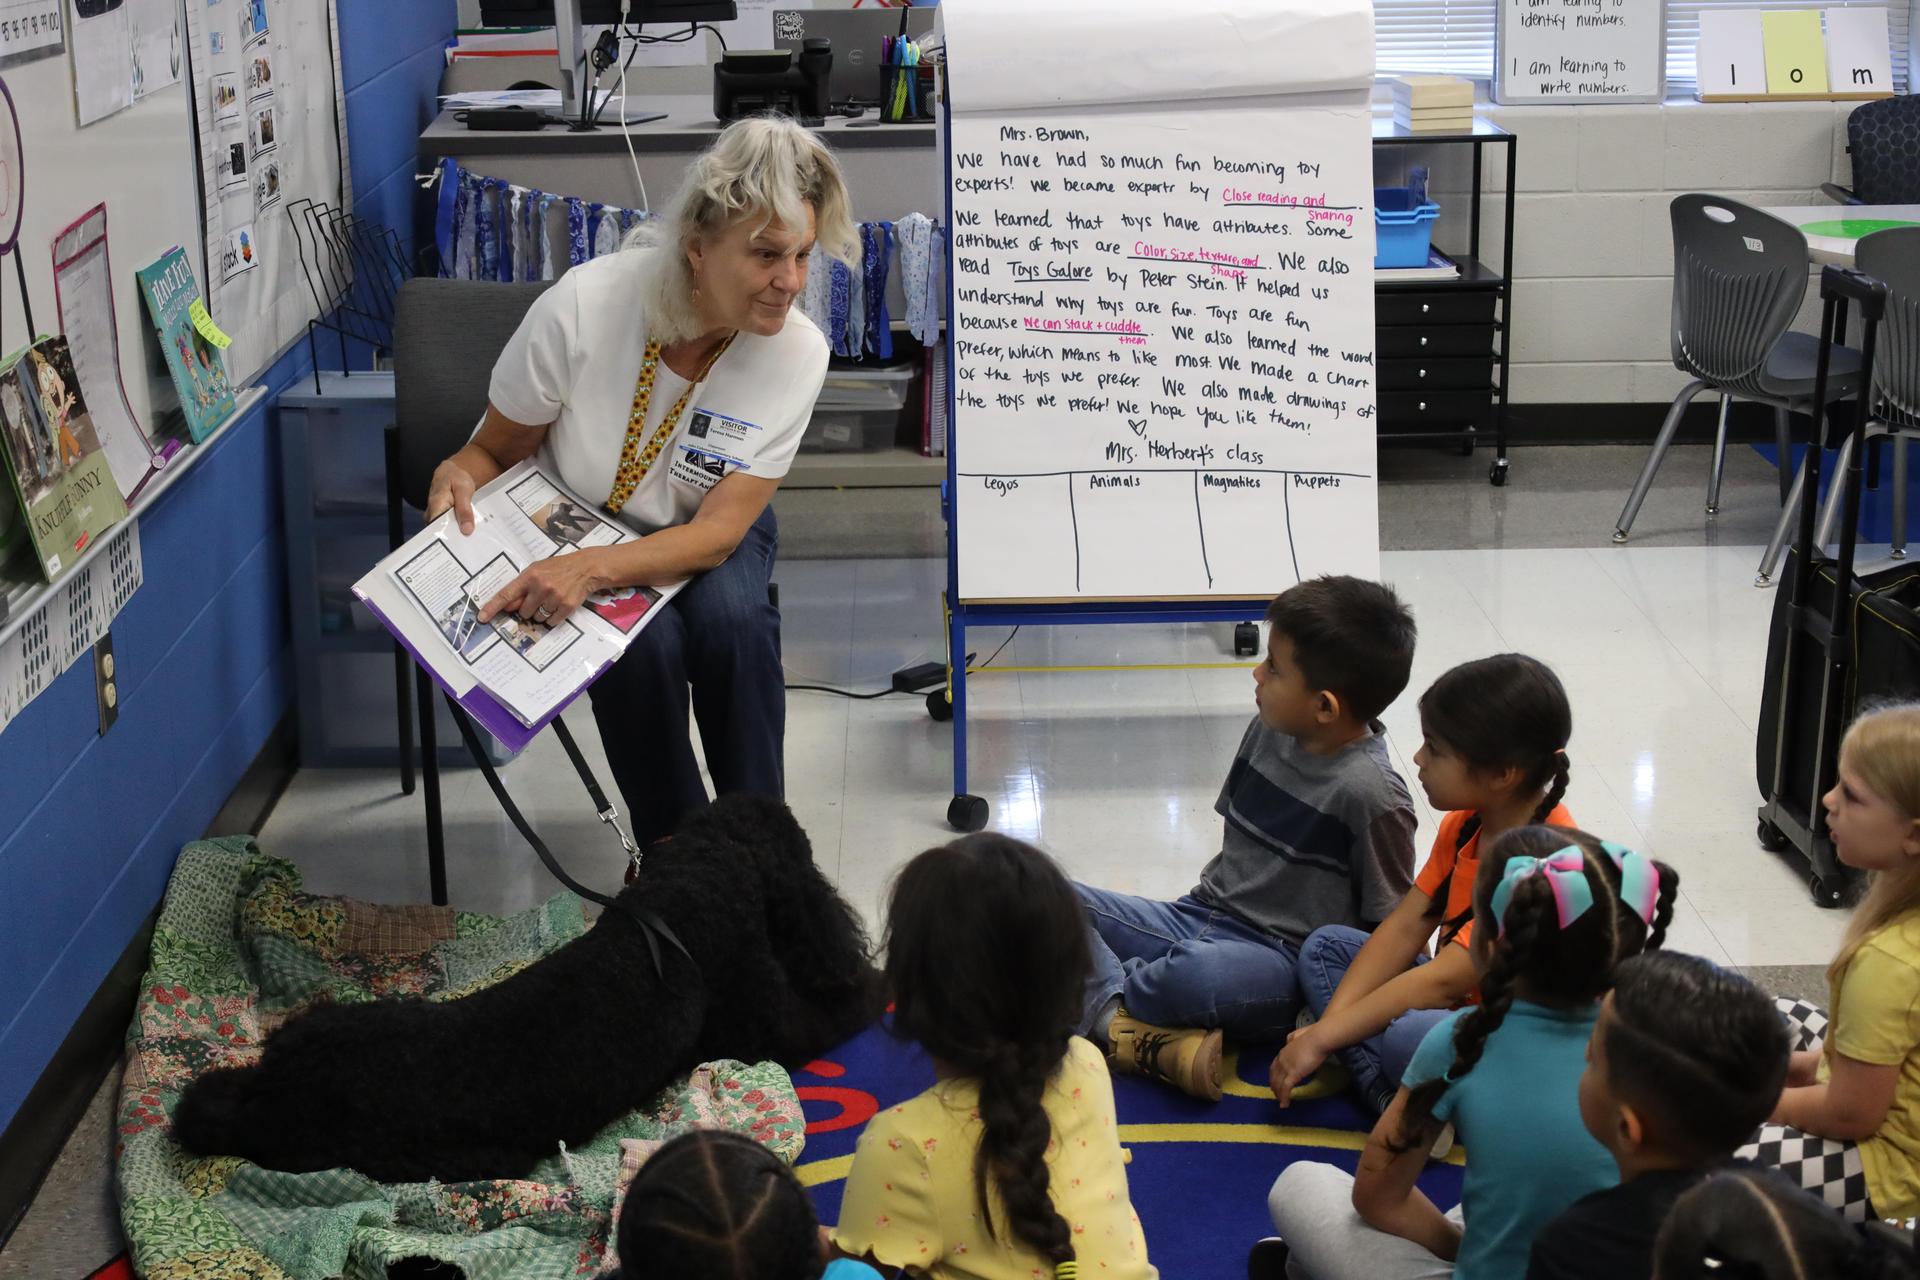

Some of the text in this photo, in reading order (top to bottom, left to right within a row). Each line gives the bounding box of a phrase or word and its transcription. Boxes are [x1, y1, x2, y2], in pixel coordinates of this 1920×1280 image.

[1521, 13, 1626, 30] identify numbers.
[1513, 56, 1626, 79] I am learning to
[1790, 69, 1803, 83] o
[1852, 69, 1873, 84] m
[1541, 80, 1629, 94] write numbers.
[1000, 126, 1090, 142] Mrs. Brown,
[957, 151, 1320, 184] We have had so much fun becoming toy
[955, 176, 1014, 194] experts!
[1064, 178, 1115, 192] became
[1190, 181, 1209, 201] by
[1257, 191, 1297, 209] reading
[1303, 193, 1325, 207] and
[955, 209, 1353, 239] We learned that toys have attributes. Some
[223, 240, 239, 272] stack
[955, 234, 1019, 250] attributes
[1029, 237, 1043, 251] of
[1051, 237, 1079, 254] toys
[1096, 241, 1120, 254] are
[1241, 255, 1258, 267] and
[1278, 252, 1306, 270] We
[1318, 256, 1350, 274] also
[959, 257, 1329, 300] read Toys Galore by Peter Stein. It helped us
[1211, 264, 1247, 279] shape
[959, 288, 1310, 332] understand why toys are fun. Toys are fun
[960, 313, 1018, 330] because
[1105, 319, 1141, 334] cuddle
[1172, 326, 1195, 340] We
[1205, 330, 1233, 345] also
[1248, 331, 1296, 355] learned
[1308, 343, 1330, 358] the
[1341, 351, 1374, 366] word
[1119, 337, 1146, 345] them
[1009, 344, 1053, 360] which
[1062, 347, 1100, 362] means
[1108, 349, 1120, 362] to
[1133, 349, 1157, 366] like
[1176, 353, 1212, 369] most.
[1219, 356, 1241, 370] We
[1251, 361, 1294, 382] made
[1308, 372, 1319, 383] a
[984, 367, 1012, 381] the
[1023, 369, 1050, 387] toys
[1061, 371, 1084, 382] we
[1097, 373, 1140, 389] prefer.
[1162, 376, 1186, 396] We
[1202, 380, 1228, 399] also
[1239, 385, 1277, 404] made
[1287, 391, 1346, 419] drawings
[1357, 406, 1376, 419] of
[957, 389, 986, 409] the
[996, 393, 1024, 411] toys
[1068, 396, 1109, 412] prefer!
[1117, 400, 1140, 414] We
[1151, 402, 1185, 420] hope
[1197, 406, 1229, 428] you
[1237, 411, 1257, 425] like
[1269, 409, 1311, 436] them!
[721, 420, 747, 432] VISITOR
[1106, 440, 1264, 466] Mrs. Herbert's class
[984, 476, 1019, 497] Legos
[1090, 475, 1140, 489] Animals
[1294, 474, 1340, 489] Puppets
